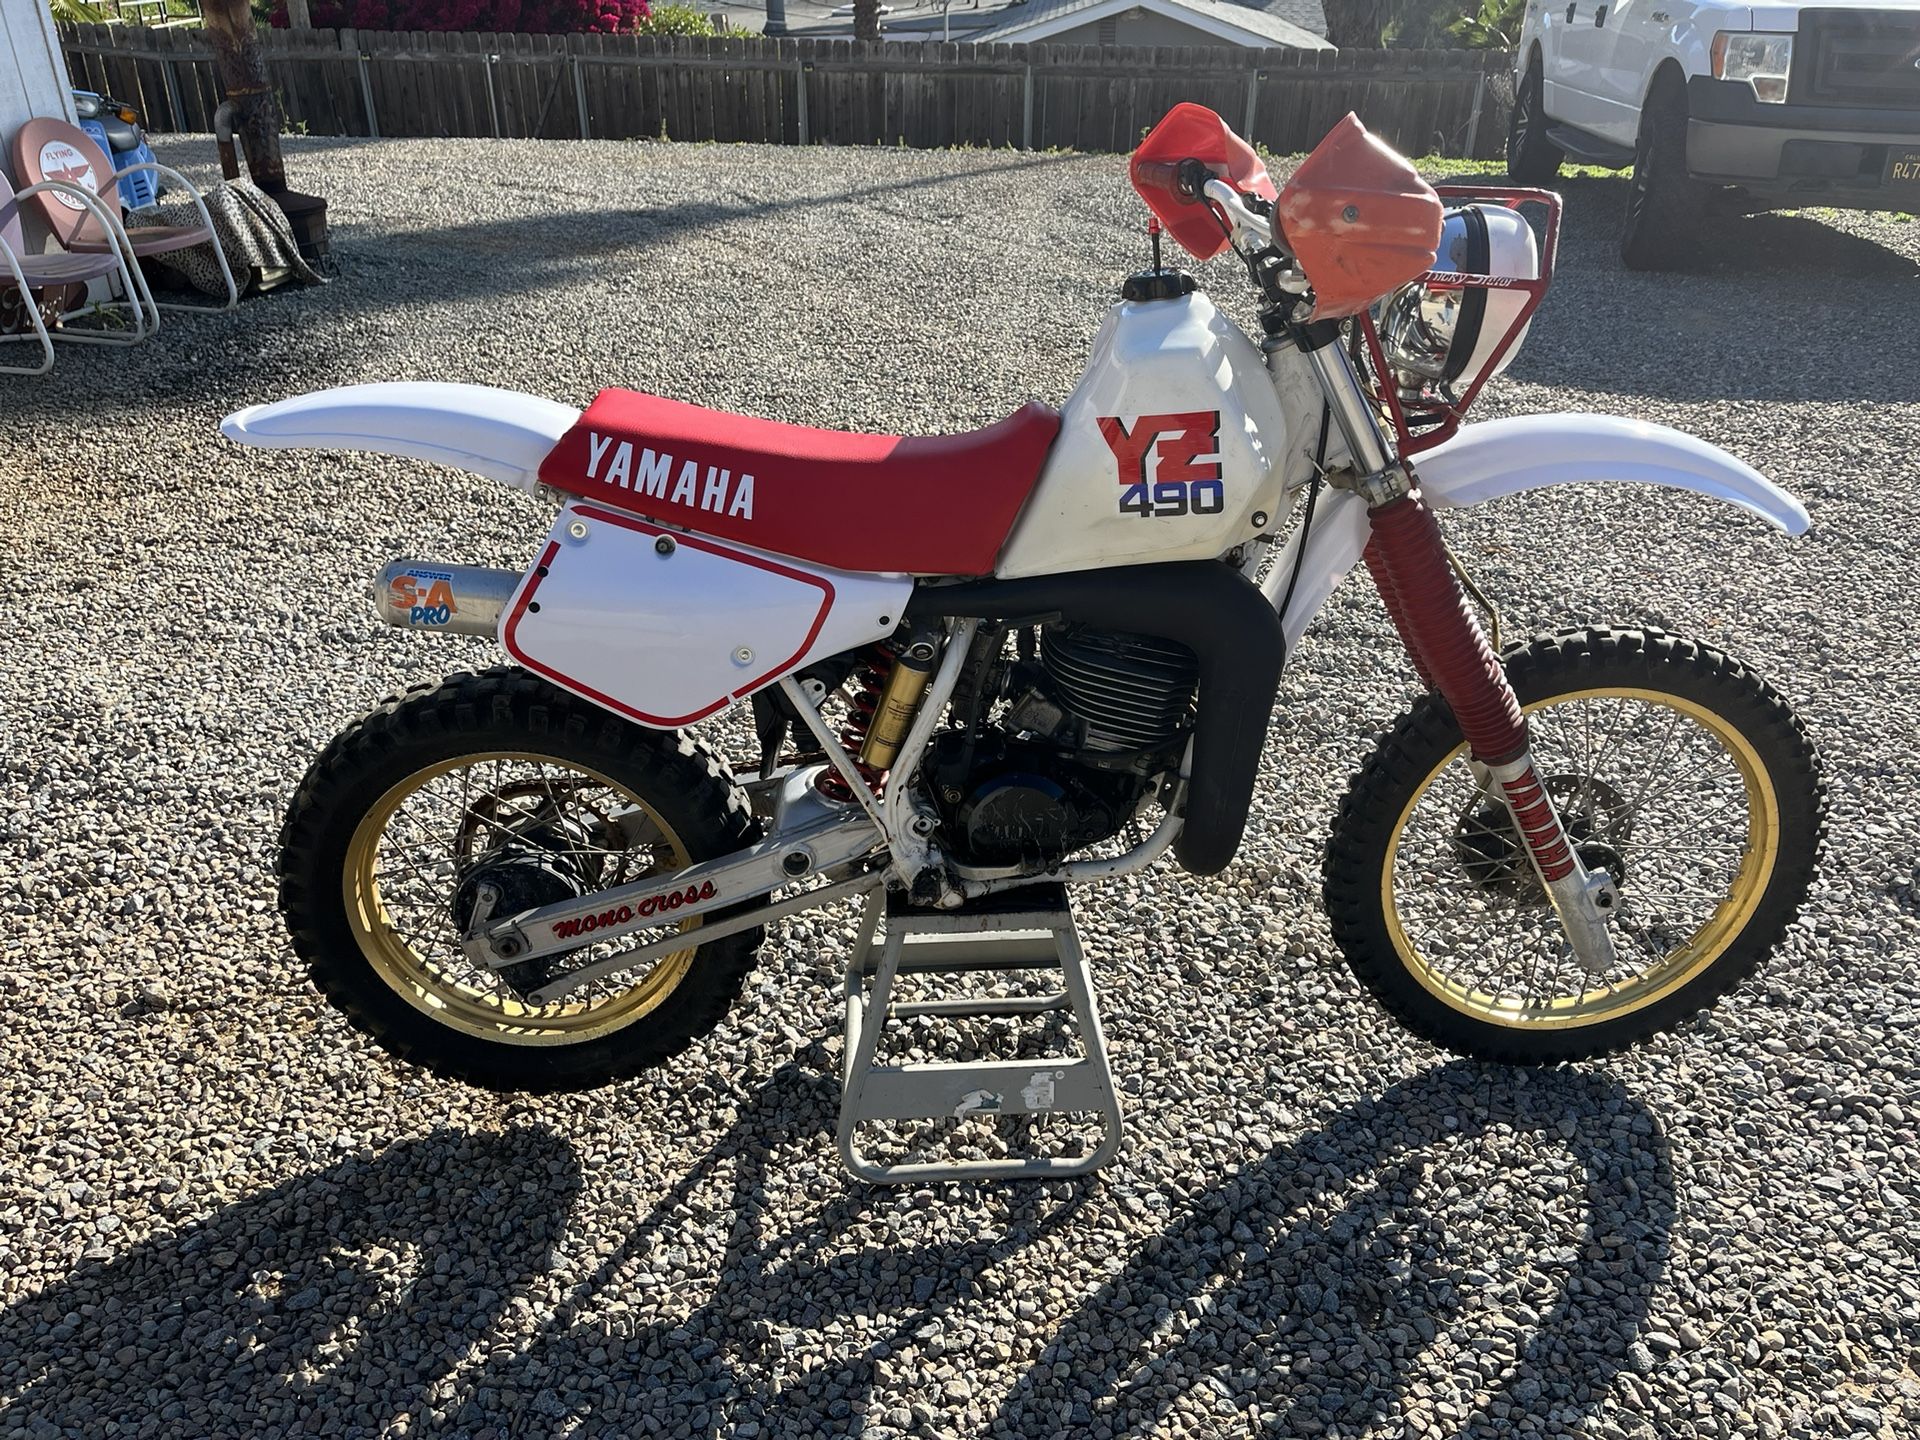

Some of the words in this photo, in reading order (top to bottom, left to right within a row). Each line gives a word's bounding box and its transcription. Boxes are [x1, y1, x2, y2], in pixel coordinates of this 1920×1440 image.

[45, 148, 74, 161] FLYING
[1892, 162, 1920, 179] R47
[1096, 410, 1222, 485] YZ
[586, 432, 755, 520] YAMAHA
[1119, 480, 1224, 517] 490
[407, 569, 452, 581] ANSWER
[410, 604, 451, 625] PRO
[1501, 765, 1576, 882] YAMAHA
[552, 905, 635, 938] mono
[638, 880, 718, 917] cross
